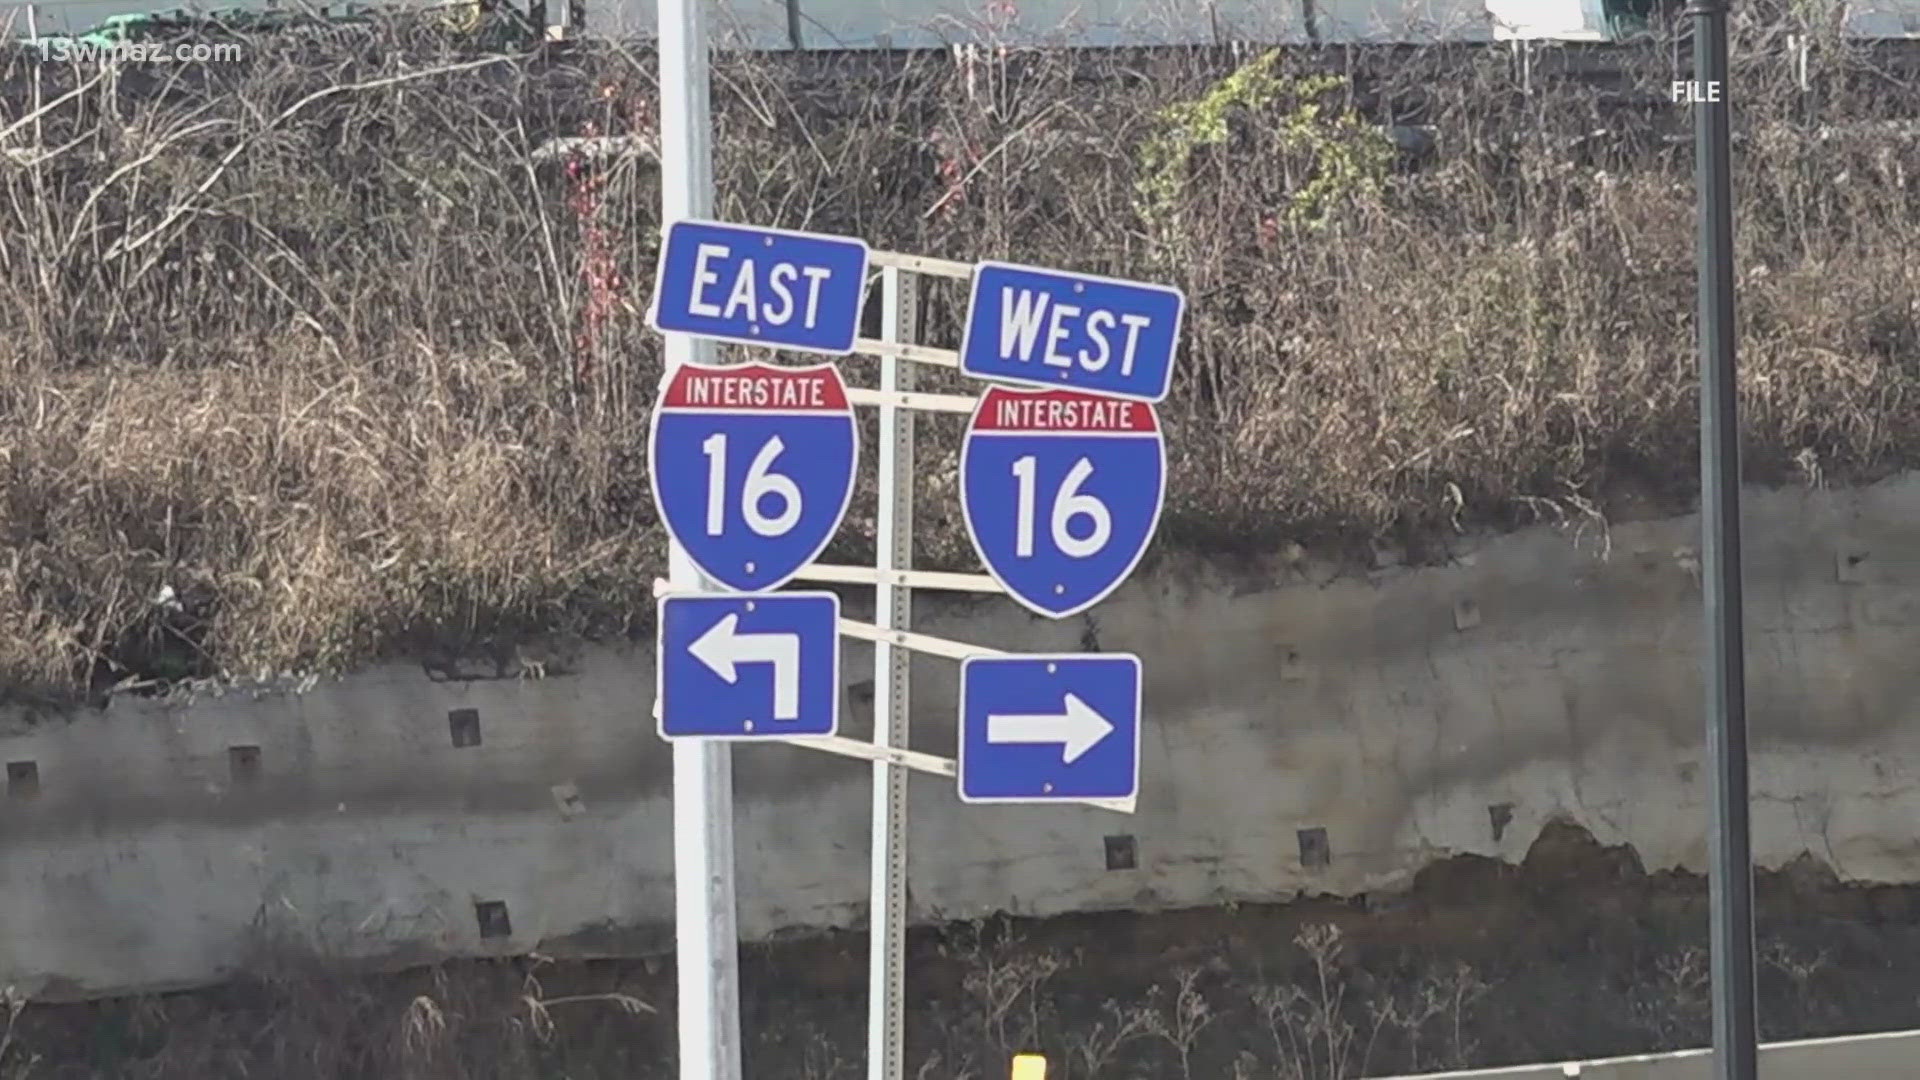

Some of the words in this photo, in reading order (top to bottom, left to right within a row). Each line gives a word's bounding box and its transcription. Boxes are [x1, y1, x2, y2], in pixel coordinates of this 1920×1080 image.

[688, 243, 832, 329] EAST
[999, 286, 1152, 377] WEST
[685, 377, 825, 408] INTERSTATE
[996, 398, 1134, 429] INTERSTATE
[702, 432, 803, 538] 16
[1011, 455, 1112, 559] 16
